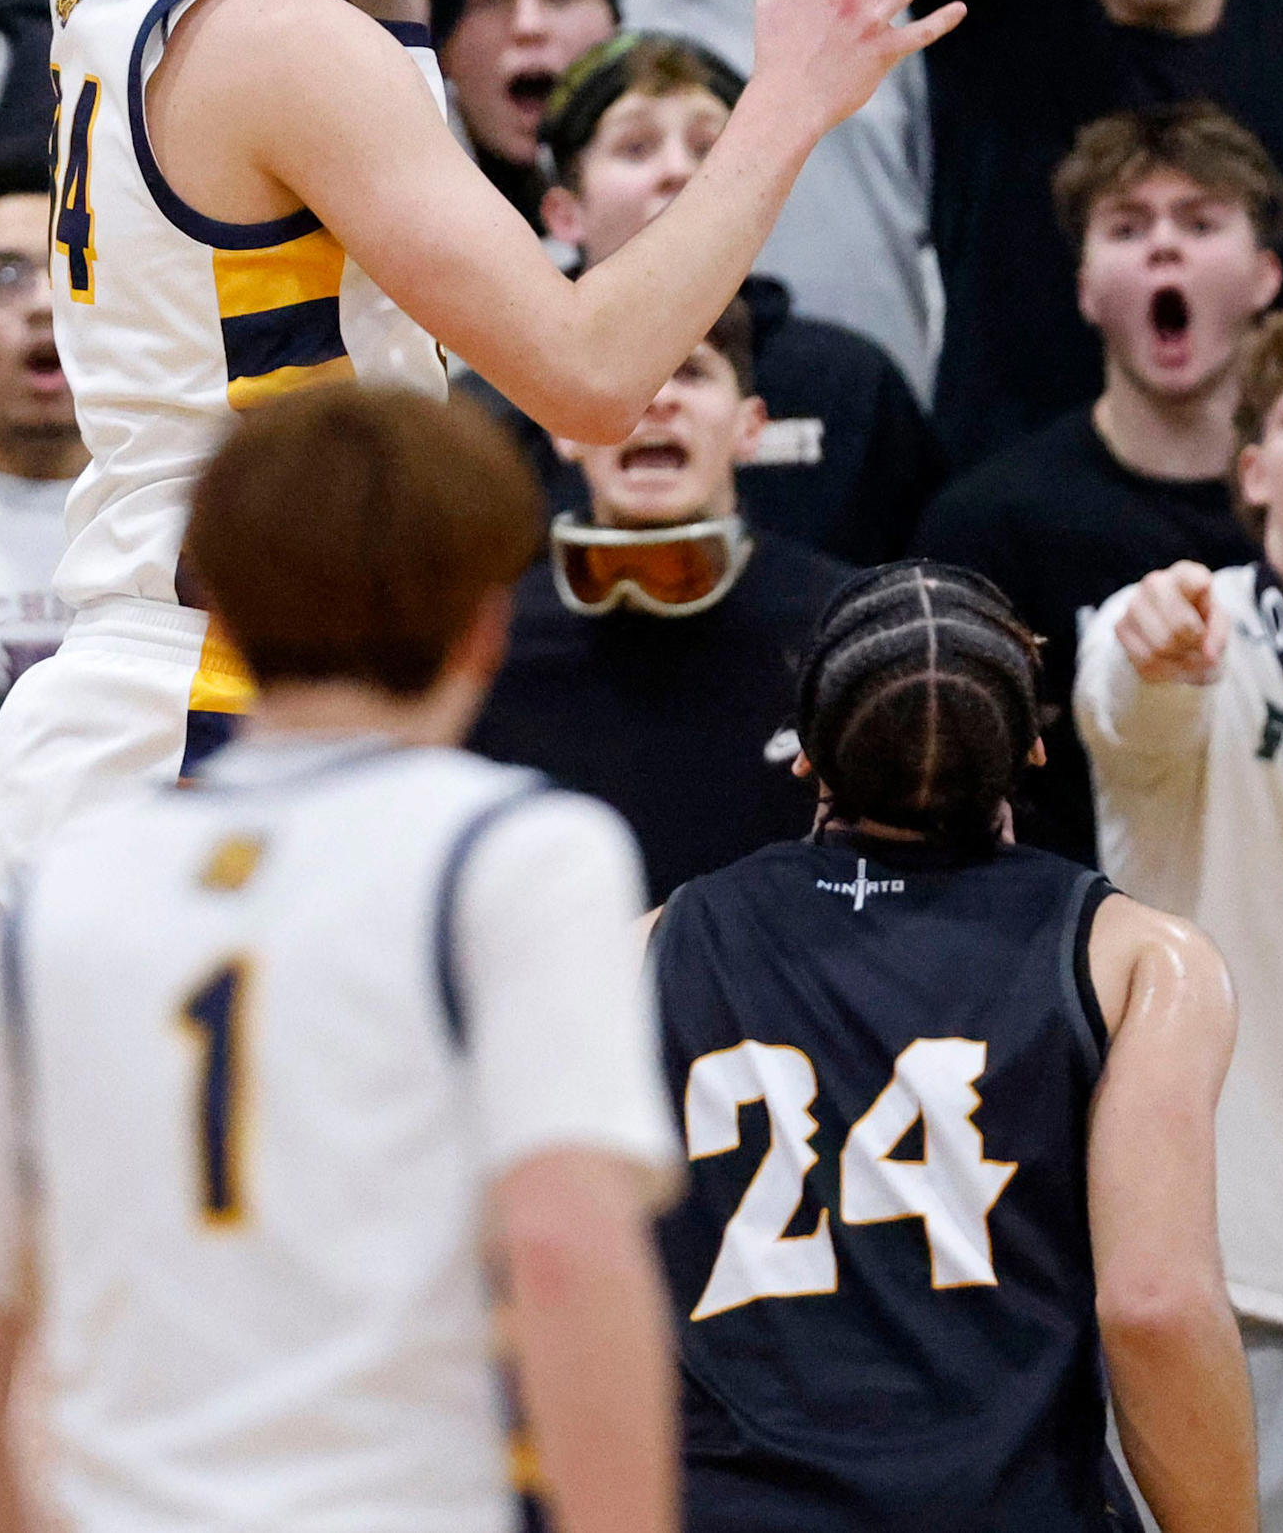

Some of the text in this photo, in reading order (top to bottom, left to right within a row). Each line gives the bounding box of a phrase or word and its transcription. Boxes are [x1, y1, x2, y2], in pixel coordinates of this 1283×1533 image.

[49, 63, 101, 305] 4
[817, 858, 905, 911] NINJATO
[179, 957, 254, 1229] 1
[685, 1036, 1019, 1322] 24
